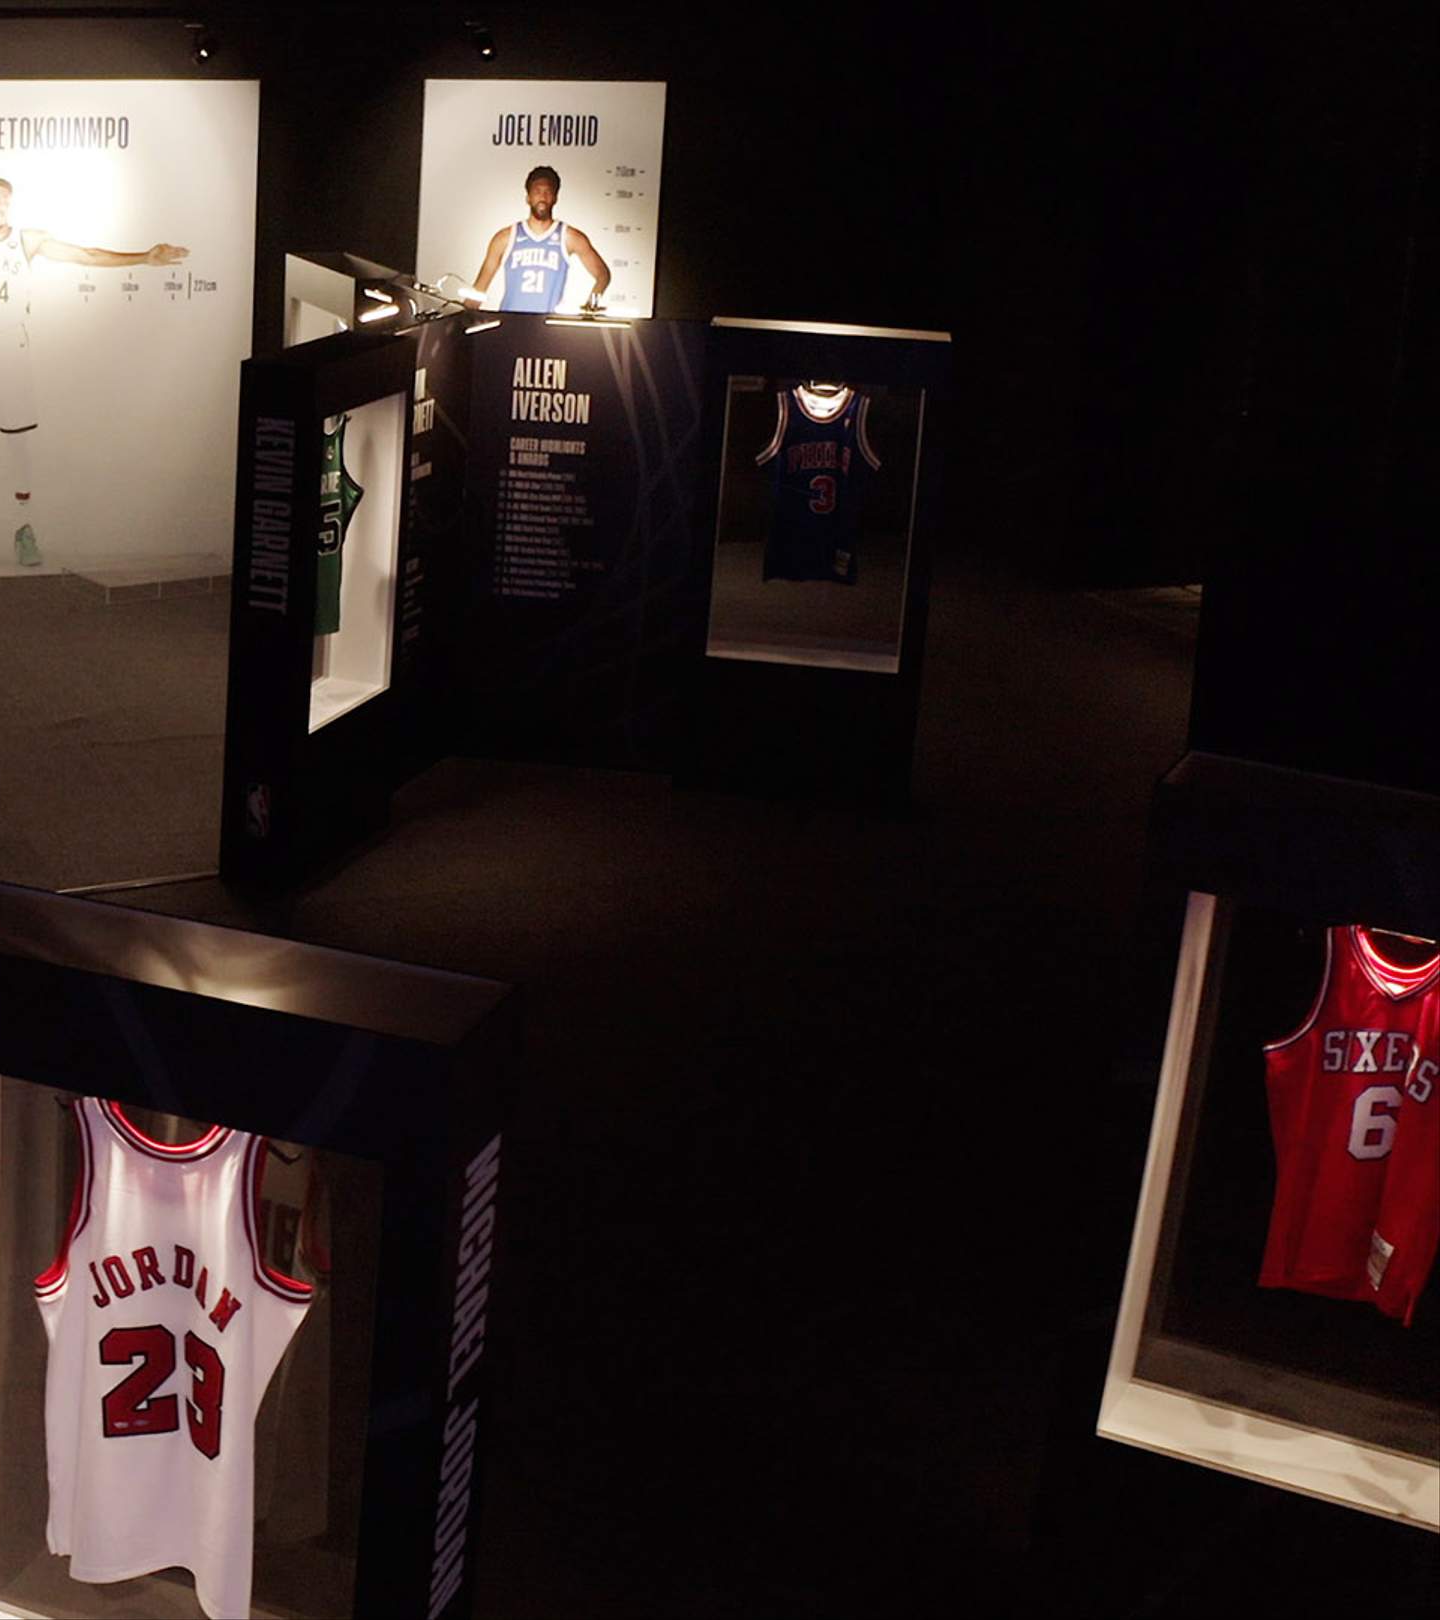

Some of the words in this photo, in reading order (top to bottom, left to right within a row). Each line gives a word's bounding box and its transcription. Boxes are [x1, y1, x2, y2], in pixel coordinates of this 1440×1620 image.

[492, 114, 533, 146] JOEL
[539, 115, 599, 146] EMBIID
[511, 248, 560, 271] PHILA
[520, 270, 545, 293] 21
[513, 357, 567, 390] ALLEN
[511, 390, 590, 424] IVERSON
[254, 415, 296, 494] KEVIN
[808, 474, 838, 514] 3
[247, 498, 292, 615] GARNETT
[1347, 1085, 1403, 1160] 6
[446, 1130, 503, 1404] MICHAEL
[99, 1324, 225, 1460] 23
[425, 1395, 480, 1620] JORDAN
